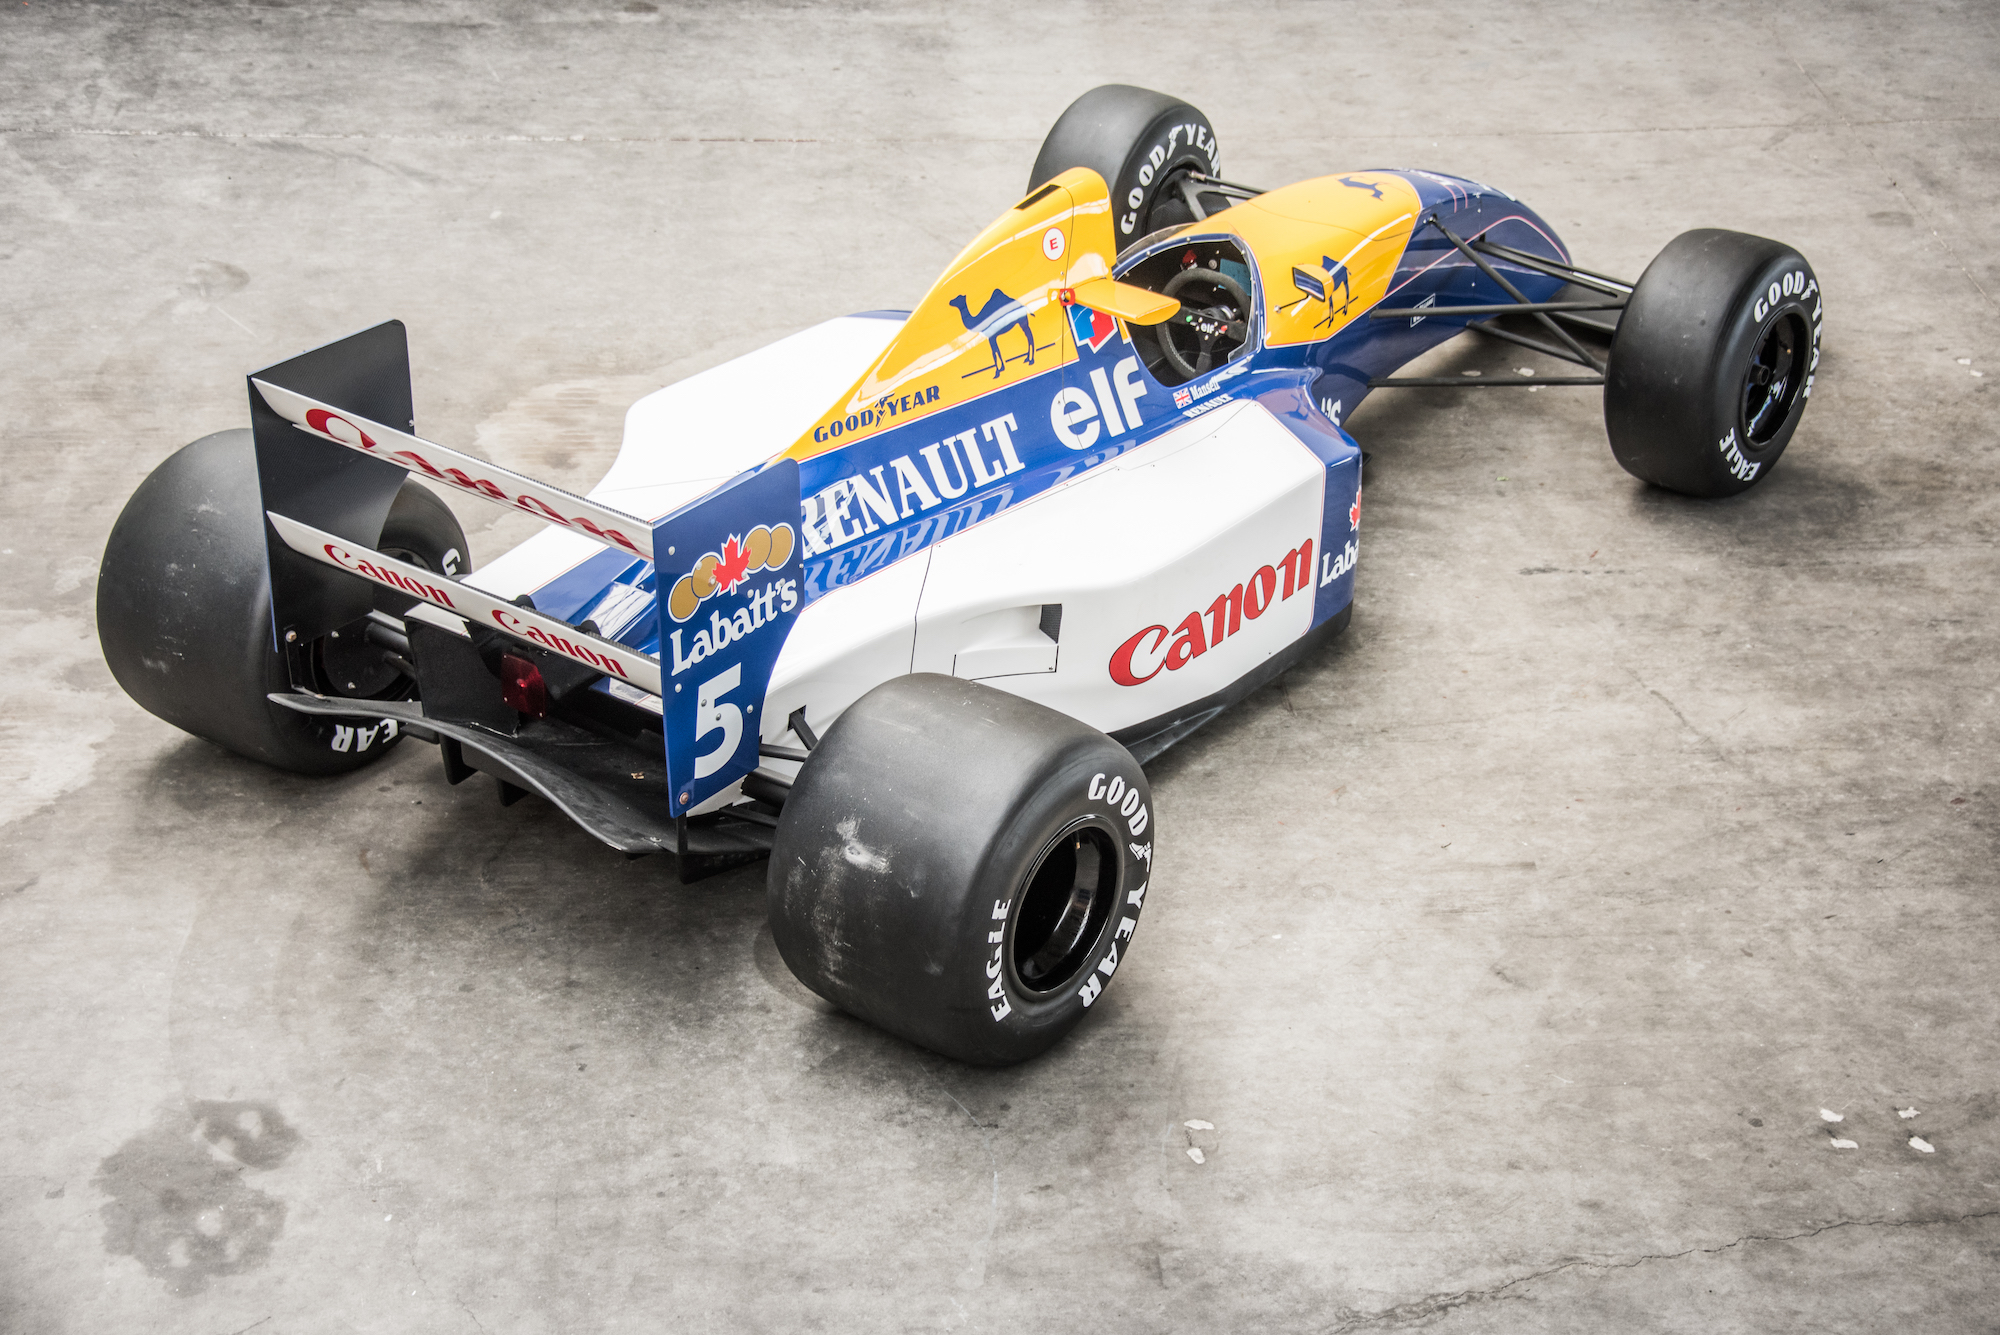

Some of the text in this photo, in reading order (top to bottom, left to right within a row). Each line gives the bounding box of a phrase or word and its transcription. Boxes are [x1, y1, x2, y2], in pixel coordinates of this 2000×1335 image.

[1049, 237, 1059, 251] E
[1200, 322, 1215, 334] elf
[1050, 356, 1148, 451] elf
[1182, 393, 1234, 418] RENAULT
[1189, 375, 1221, 400] Mansell
[801, 413, 1026, 560] RENAULT
[1719, 427, 1761, 482] EAGLE
[323, 544, 457, 610] Canon
[1108, 537, 1313, 687] Canon
[491, 609, 629, 679] Canon
[670, 579, 798, 676] Labatt's
[694, 662, 744, 780] 5
[986, 899, 1012, 1022] EAGLE
